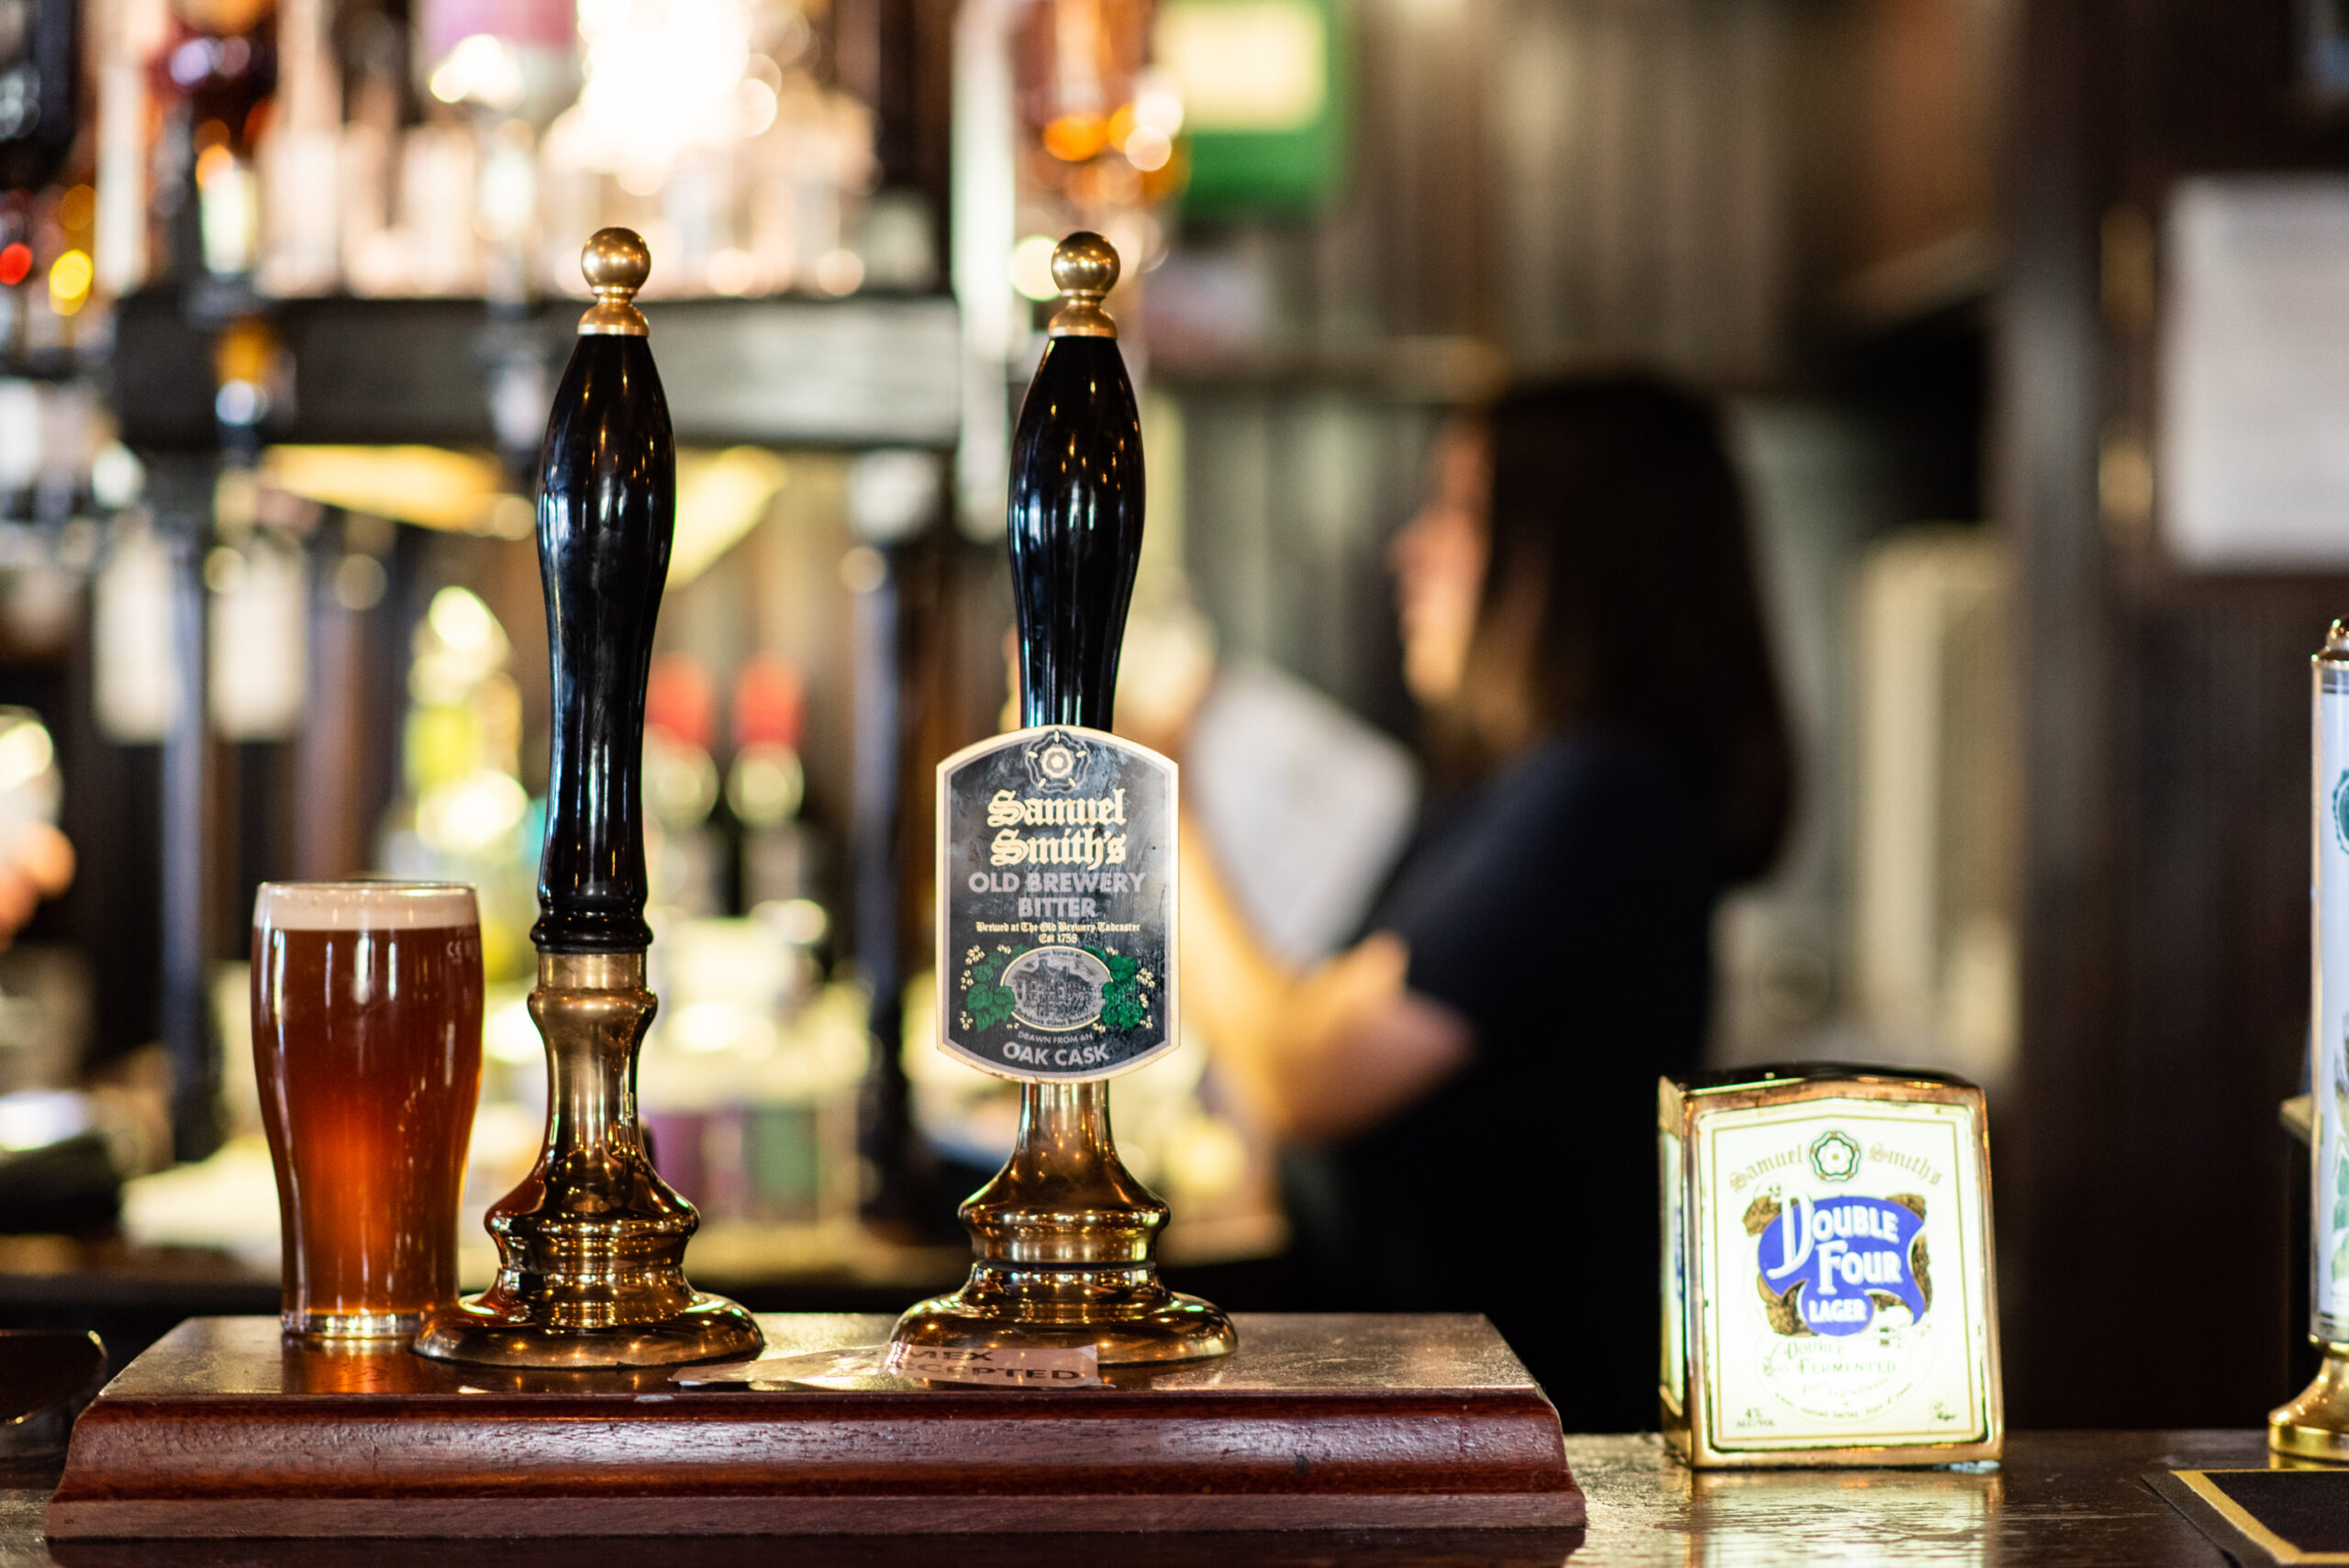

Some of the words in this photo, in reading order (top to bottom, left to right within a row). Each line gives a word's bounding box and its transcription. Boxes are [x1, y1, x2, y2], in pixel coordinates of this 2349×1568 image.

[986, 788, 1127, 827] Samuel
[990, 828, 1127, 871] Smith's
[968, 873, 1019, 893] OLD
[1026, 873, 1146, 893] BREWERY
[1019, 897, 1097, 917] BITTER
[976, 921, 1008, 932] Brewed
[1010, 923, 1019, 932] at
[1020, 921, 1039, 933] The
[1040, 921, 1056, 932] Old
[1058, 921, 1097, 933] Brewery
[1097, 921, 1141, 932] Tadcaster
[1039, 933, 1055, 943] Est
[1057, 933, 1077, 943] 1758
[1018, 1030, 1052, 1043] DRAWN
[1053, 1035, 1077, 1044] FROM
[1080, 1032, 1094, 1041] AN
[1003, 1041, 1052, 1066] OAK
[1054, 1041, 1109, 1066] CASK
[1729, 1144, 1802, 1192] Samuel
[1814, 1240, 1903, 1295] FOUR
[1808, 1298, 1867, 1323] LAGER
